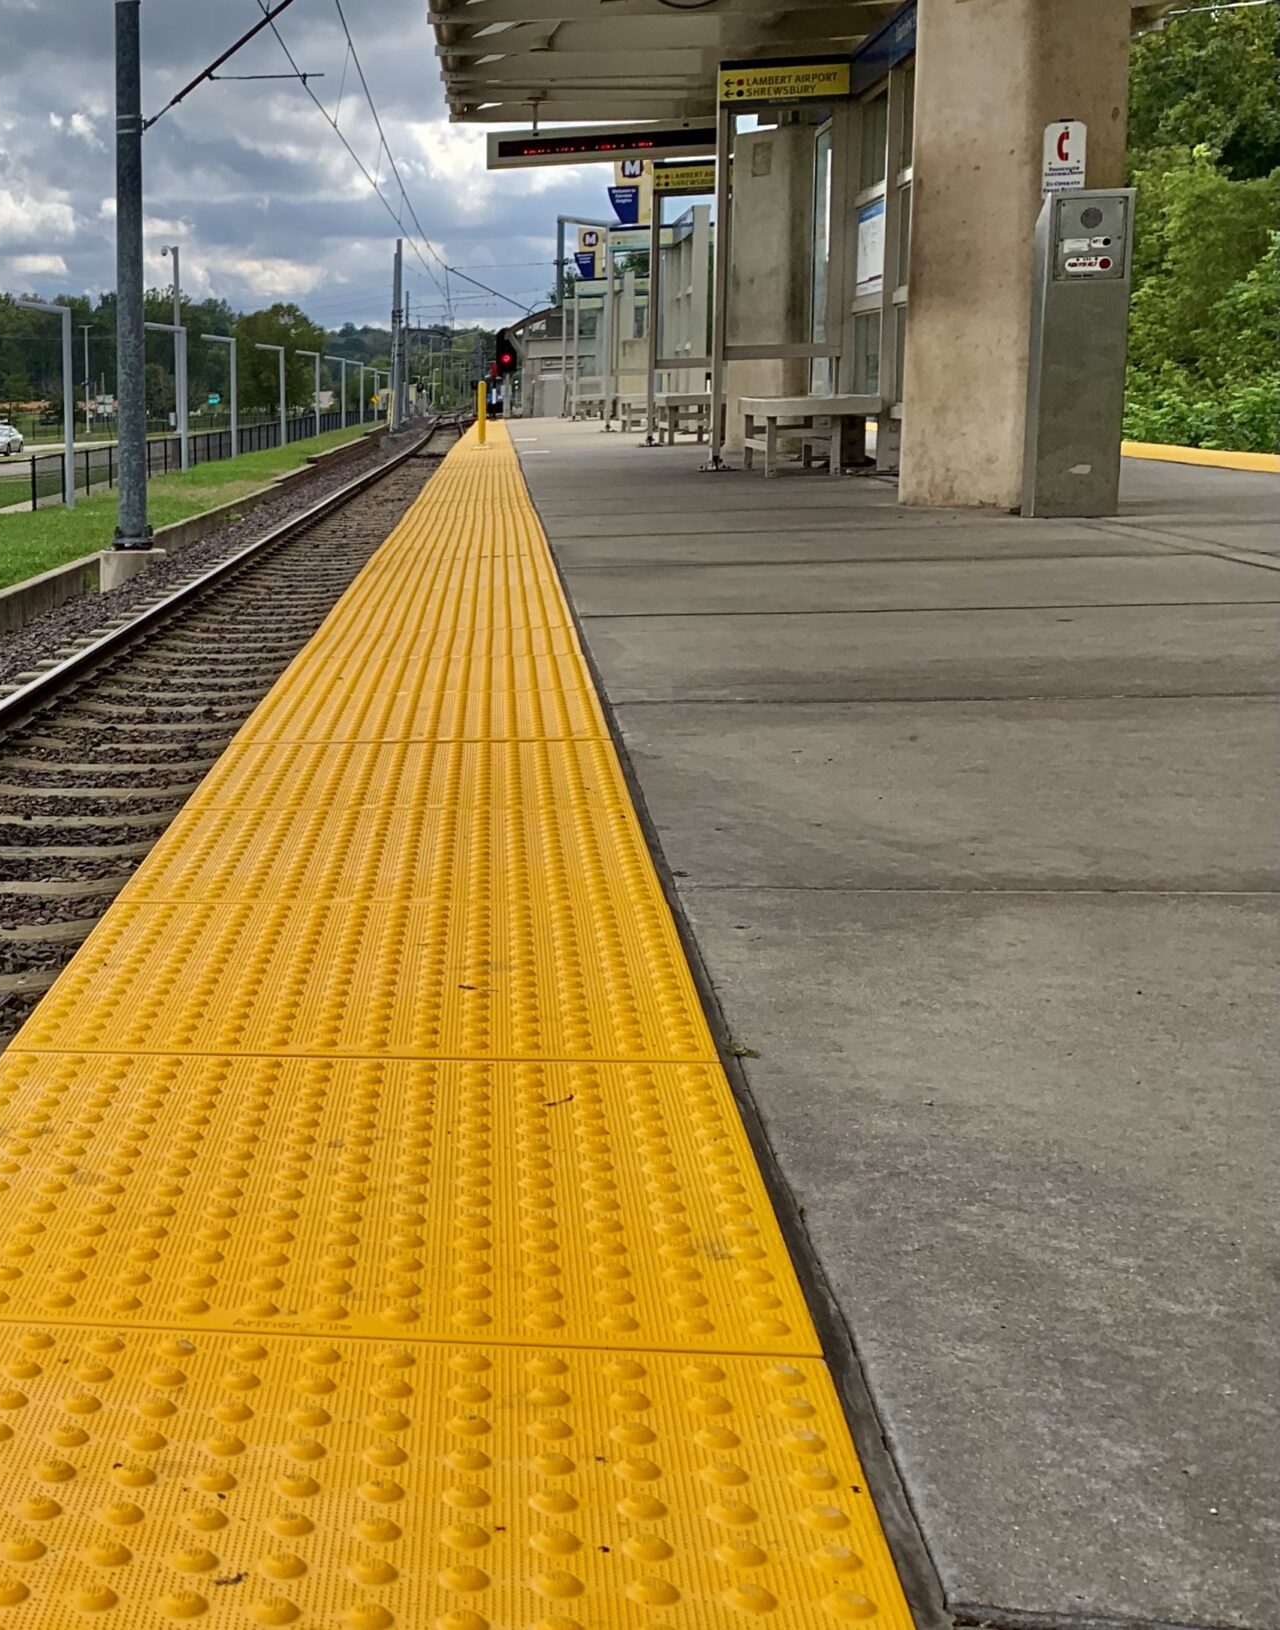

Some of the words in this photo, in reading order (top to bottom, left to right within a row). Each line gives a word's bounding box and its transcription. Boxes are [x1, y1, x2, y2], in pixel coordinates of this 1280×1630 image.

[746, 75, 792, 87] LAMBERT
[795, 72, 838, 84] AIRPORT
[746, 84, 817, 97] SHREWSBURY
[624, 160, 641, 176] M
[585, 233, 596, 245] M
